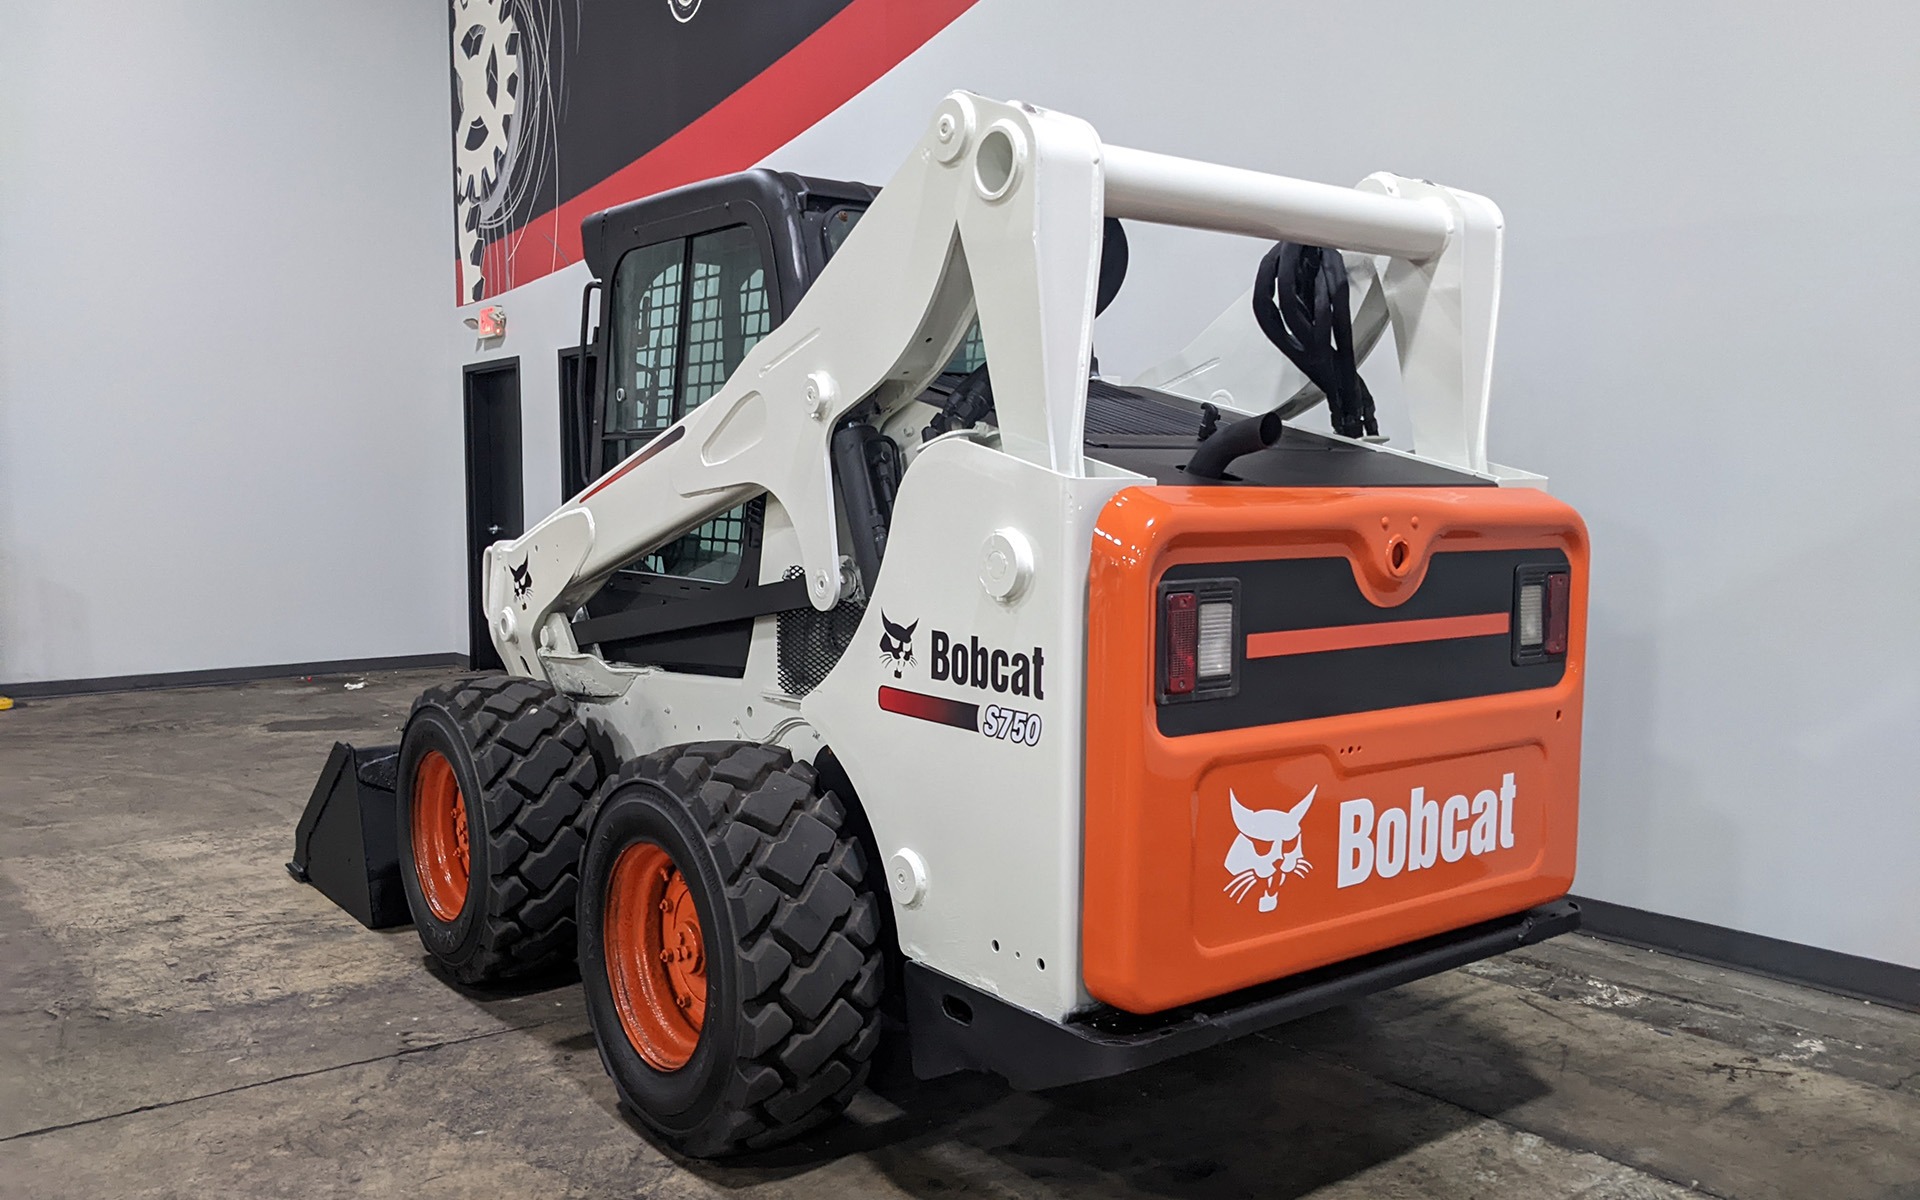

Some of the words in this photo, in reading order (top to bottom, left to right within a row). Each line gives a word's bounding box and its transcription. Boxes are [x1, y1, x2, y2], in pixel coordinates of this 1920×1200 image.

[931, 629, 1044, 700] Bobcat
[983, 704, 1042, 747] S750
[1337, 772, 1516, 889] Bobcat
